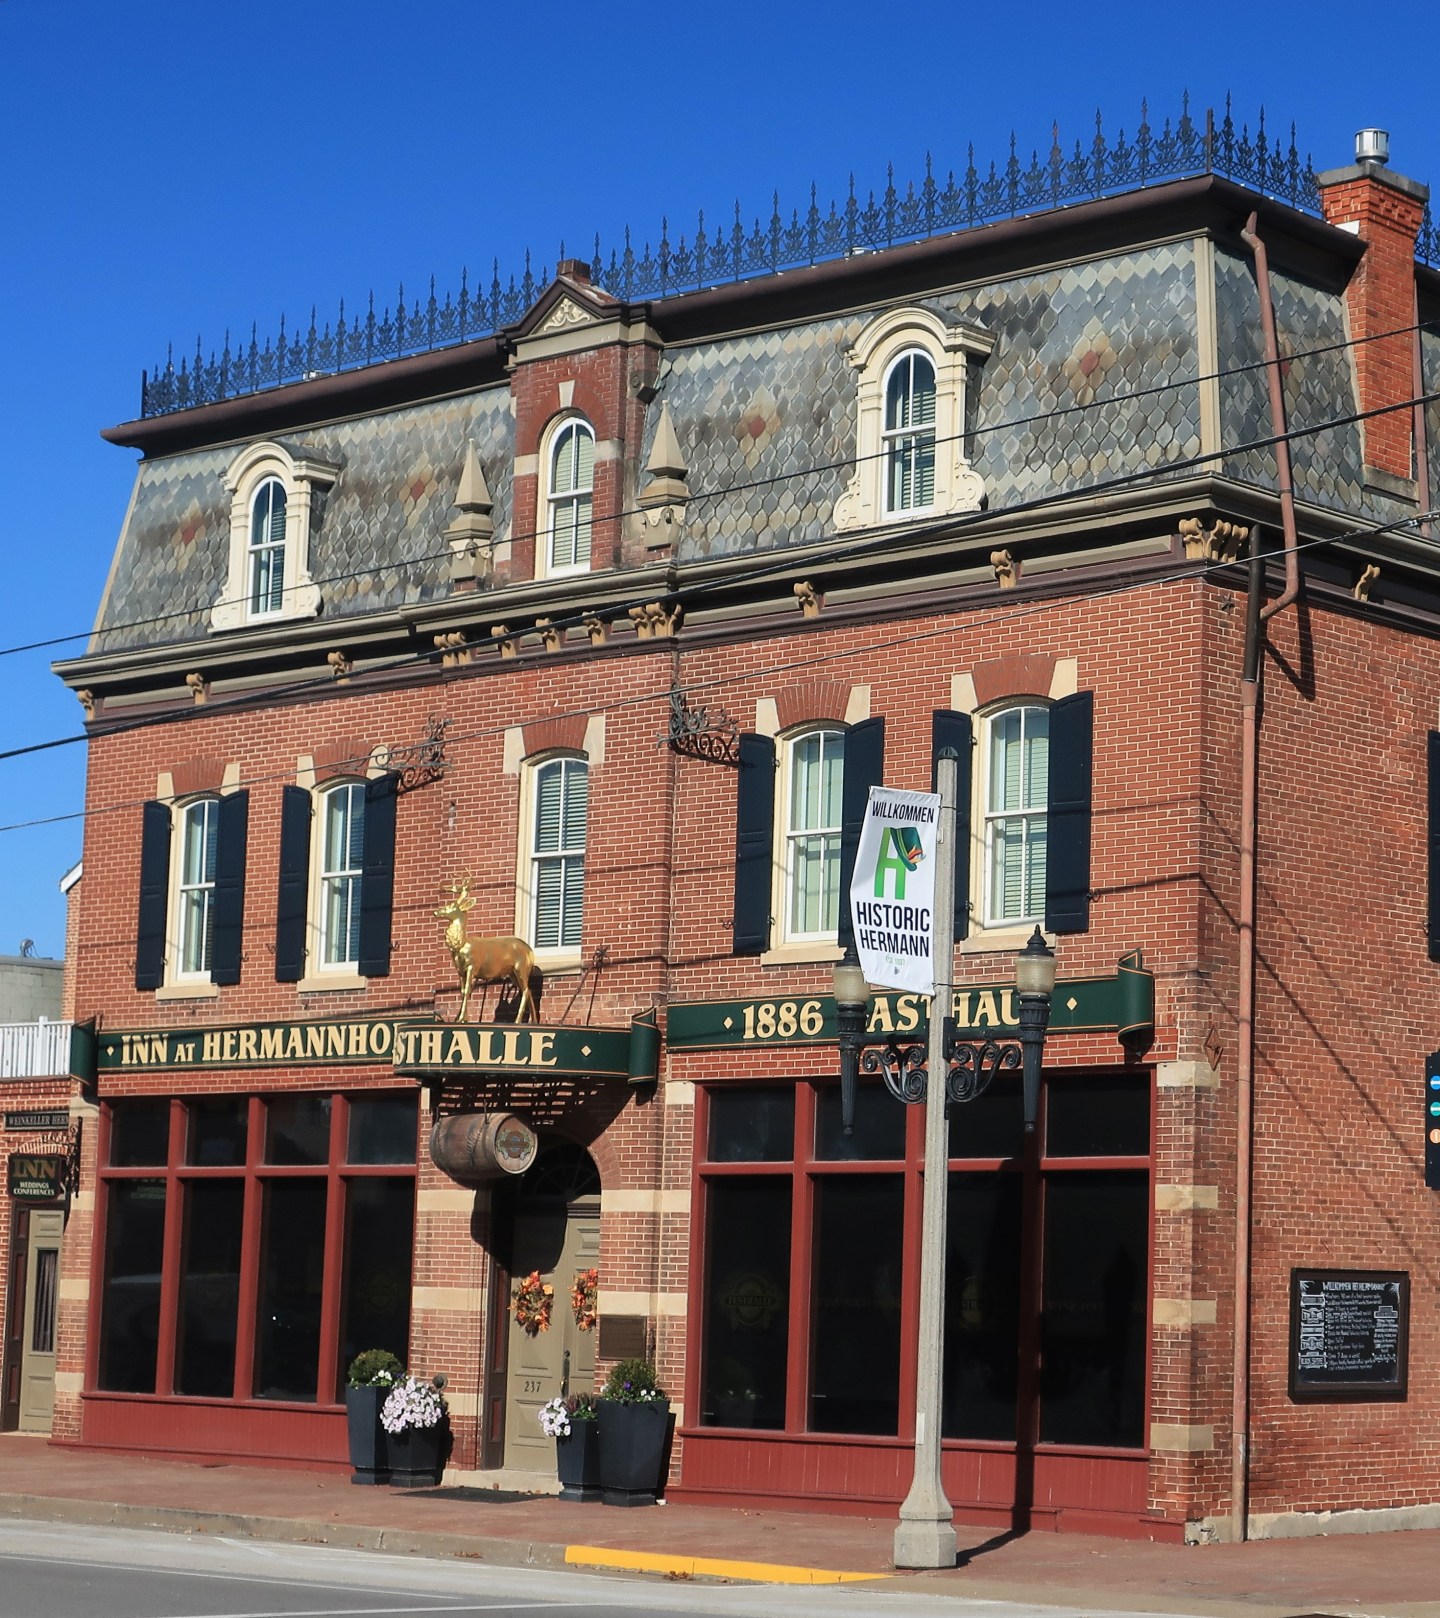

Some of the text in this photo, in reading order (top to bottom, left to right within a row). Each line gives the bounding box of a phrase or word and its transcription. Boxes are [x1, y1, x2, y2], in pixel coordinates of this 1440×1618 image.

[871, 800, 935, 823] WILLKOMMEN
[856, 901, 930, 932] HISTORIC
[860, 929, 930, 957] HERMANN
[742, 1000, 825, 1040] 1886
[121, 1033, 169, 1065] INN
[173, 1042, 196, 1063] AT
[393, 1030, 558, 1067] STHALLE
[12, 1159, 57, 1179] INN
[13, 1187, 55, 1196] CONFERENCES
[19, 1181, 50, 1189] WEDDINGS
[524, 1380, 542, 1393] 237
